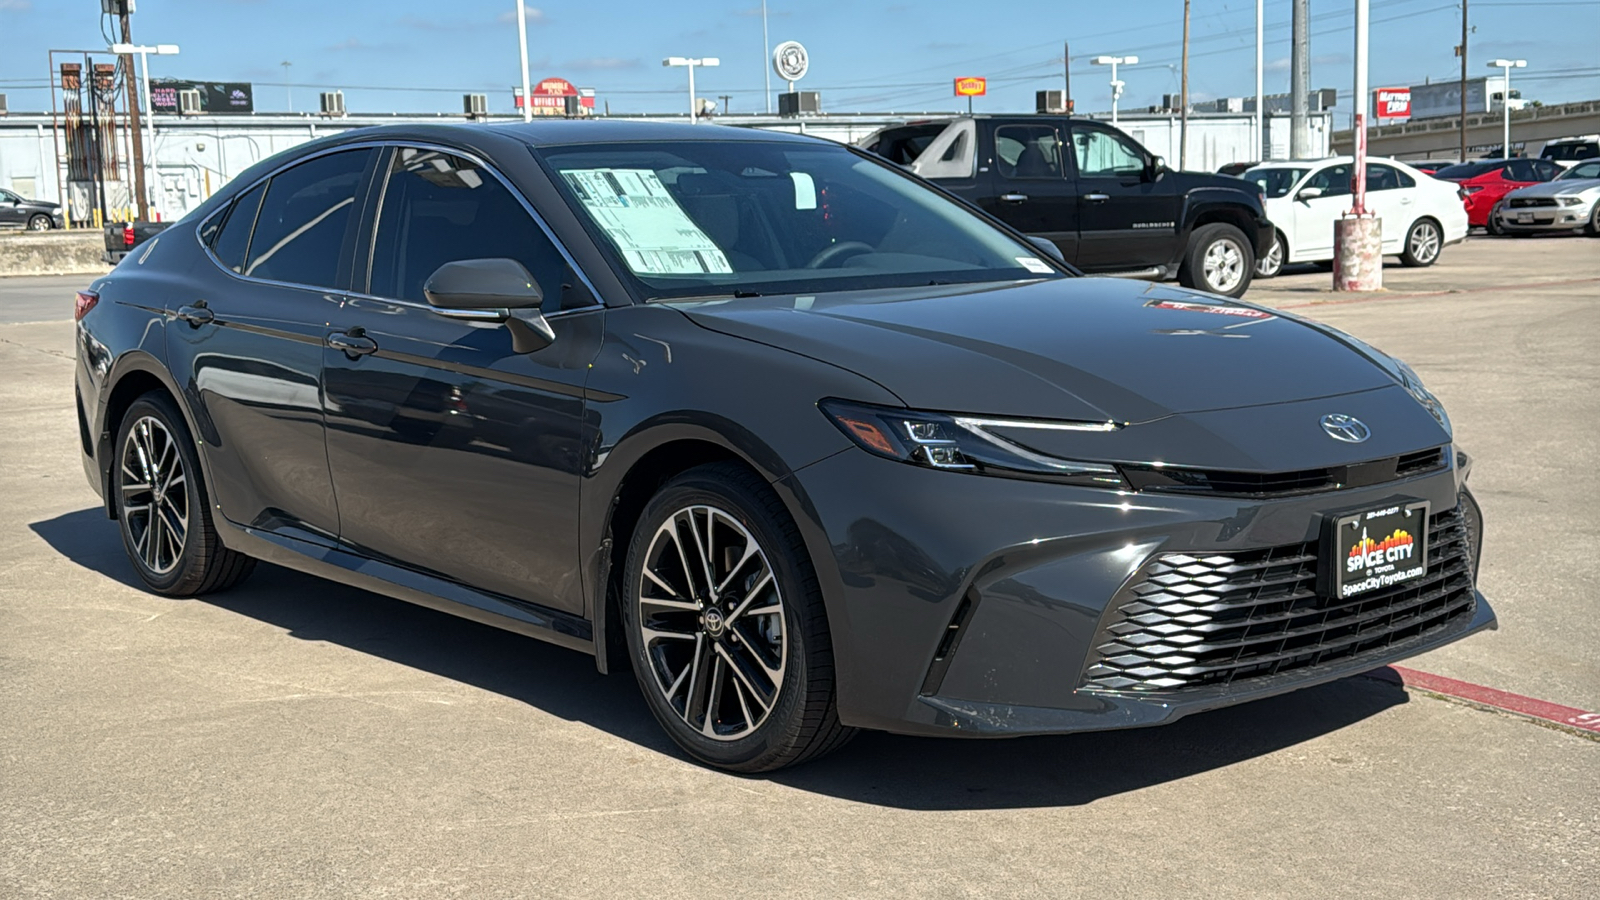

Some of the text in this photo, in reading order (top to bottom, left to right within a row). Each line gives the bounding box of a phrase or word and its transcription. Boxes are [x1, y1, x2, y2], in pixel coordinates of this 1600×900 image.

[534, 97, 555, 107] OFFICE
[1347, 542, 1414, 572] SPACE CITY
[1374, 564, 1395, 575] TOYOTA
[1342, 566, 1423, 597] SpaceCityToyota.com
